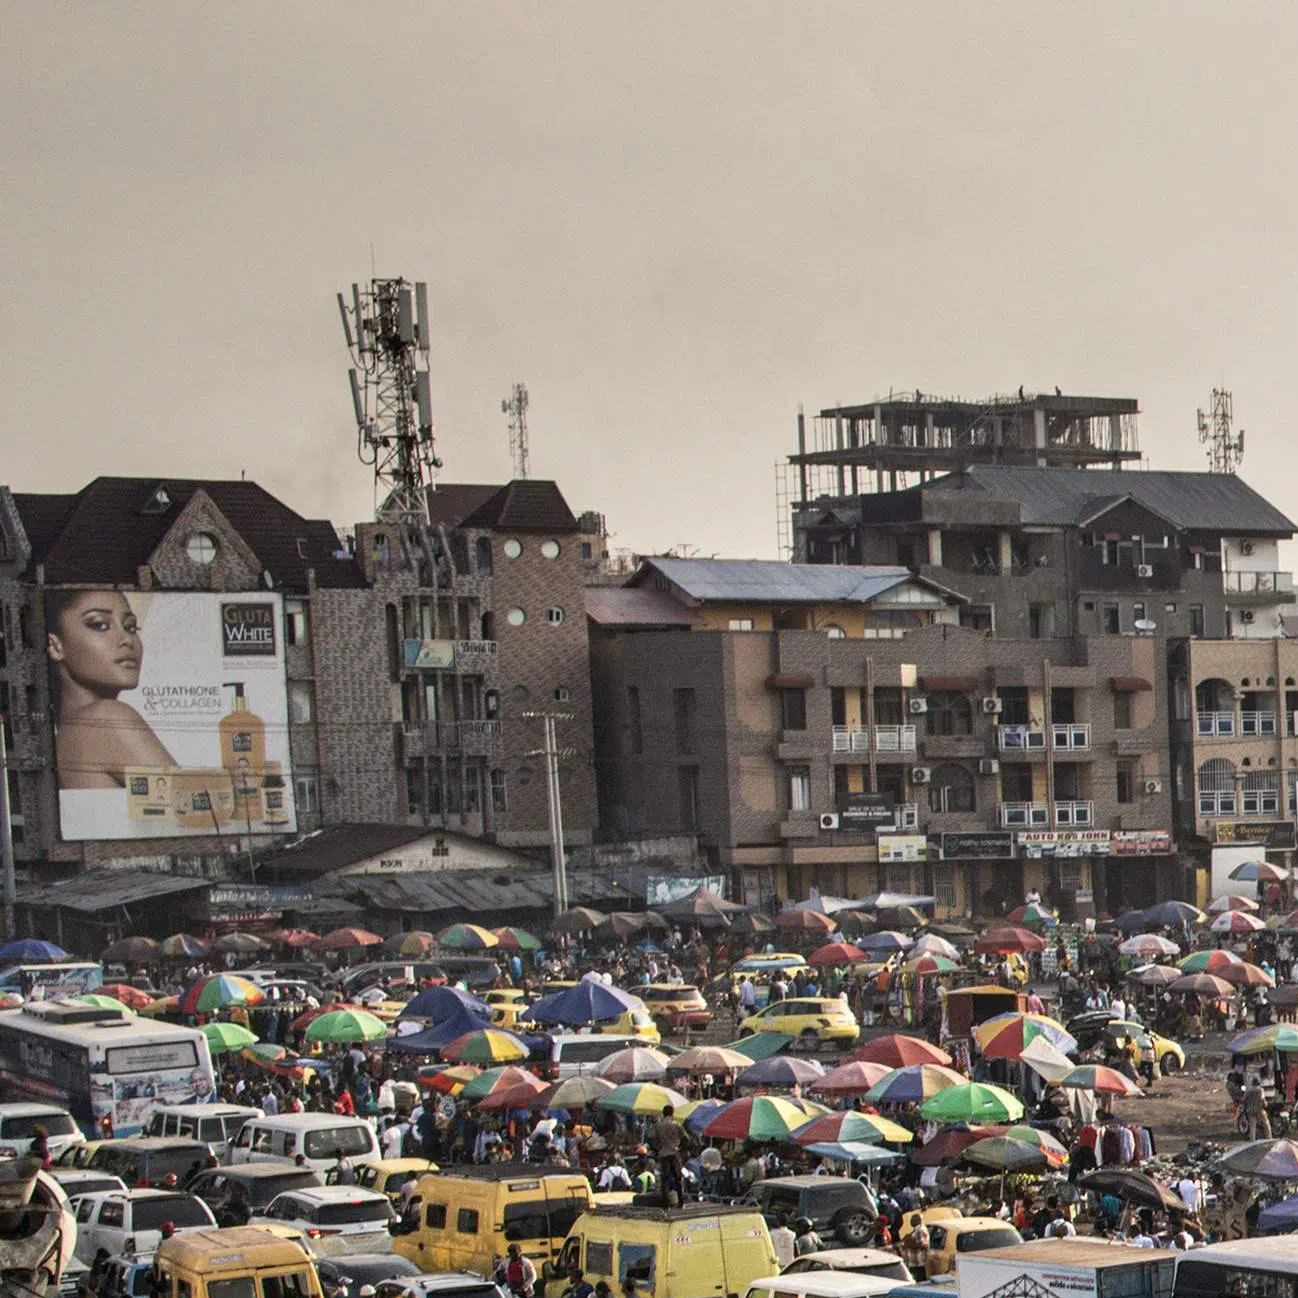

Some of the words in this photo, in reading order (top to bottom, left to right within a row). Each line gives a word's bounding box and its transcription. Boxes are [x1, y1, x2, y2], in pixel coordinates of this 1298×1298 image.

[225, 623, 273, 641] WHITE
[142, 686, 220, 697] GLUTATHIONE
[160, 697, 221, 709] COLLAGEN
